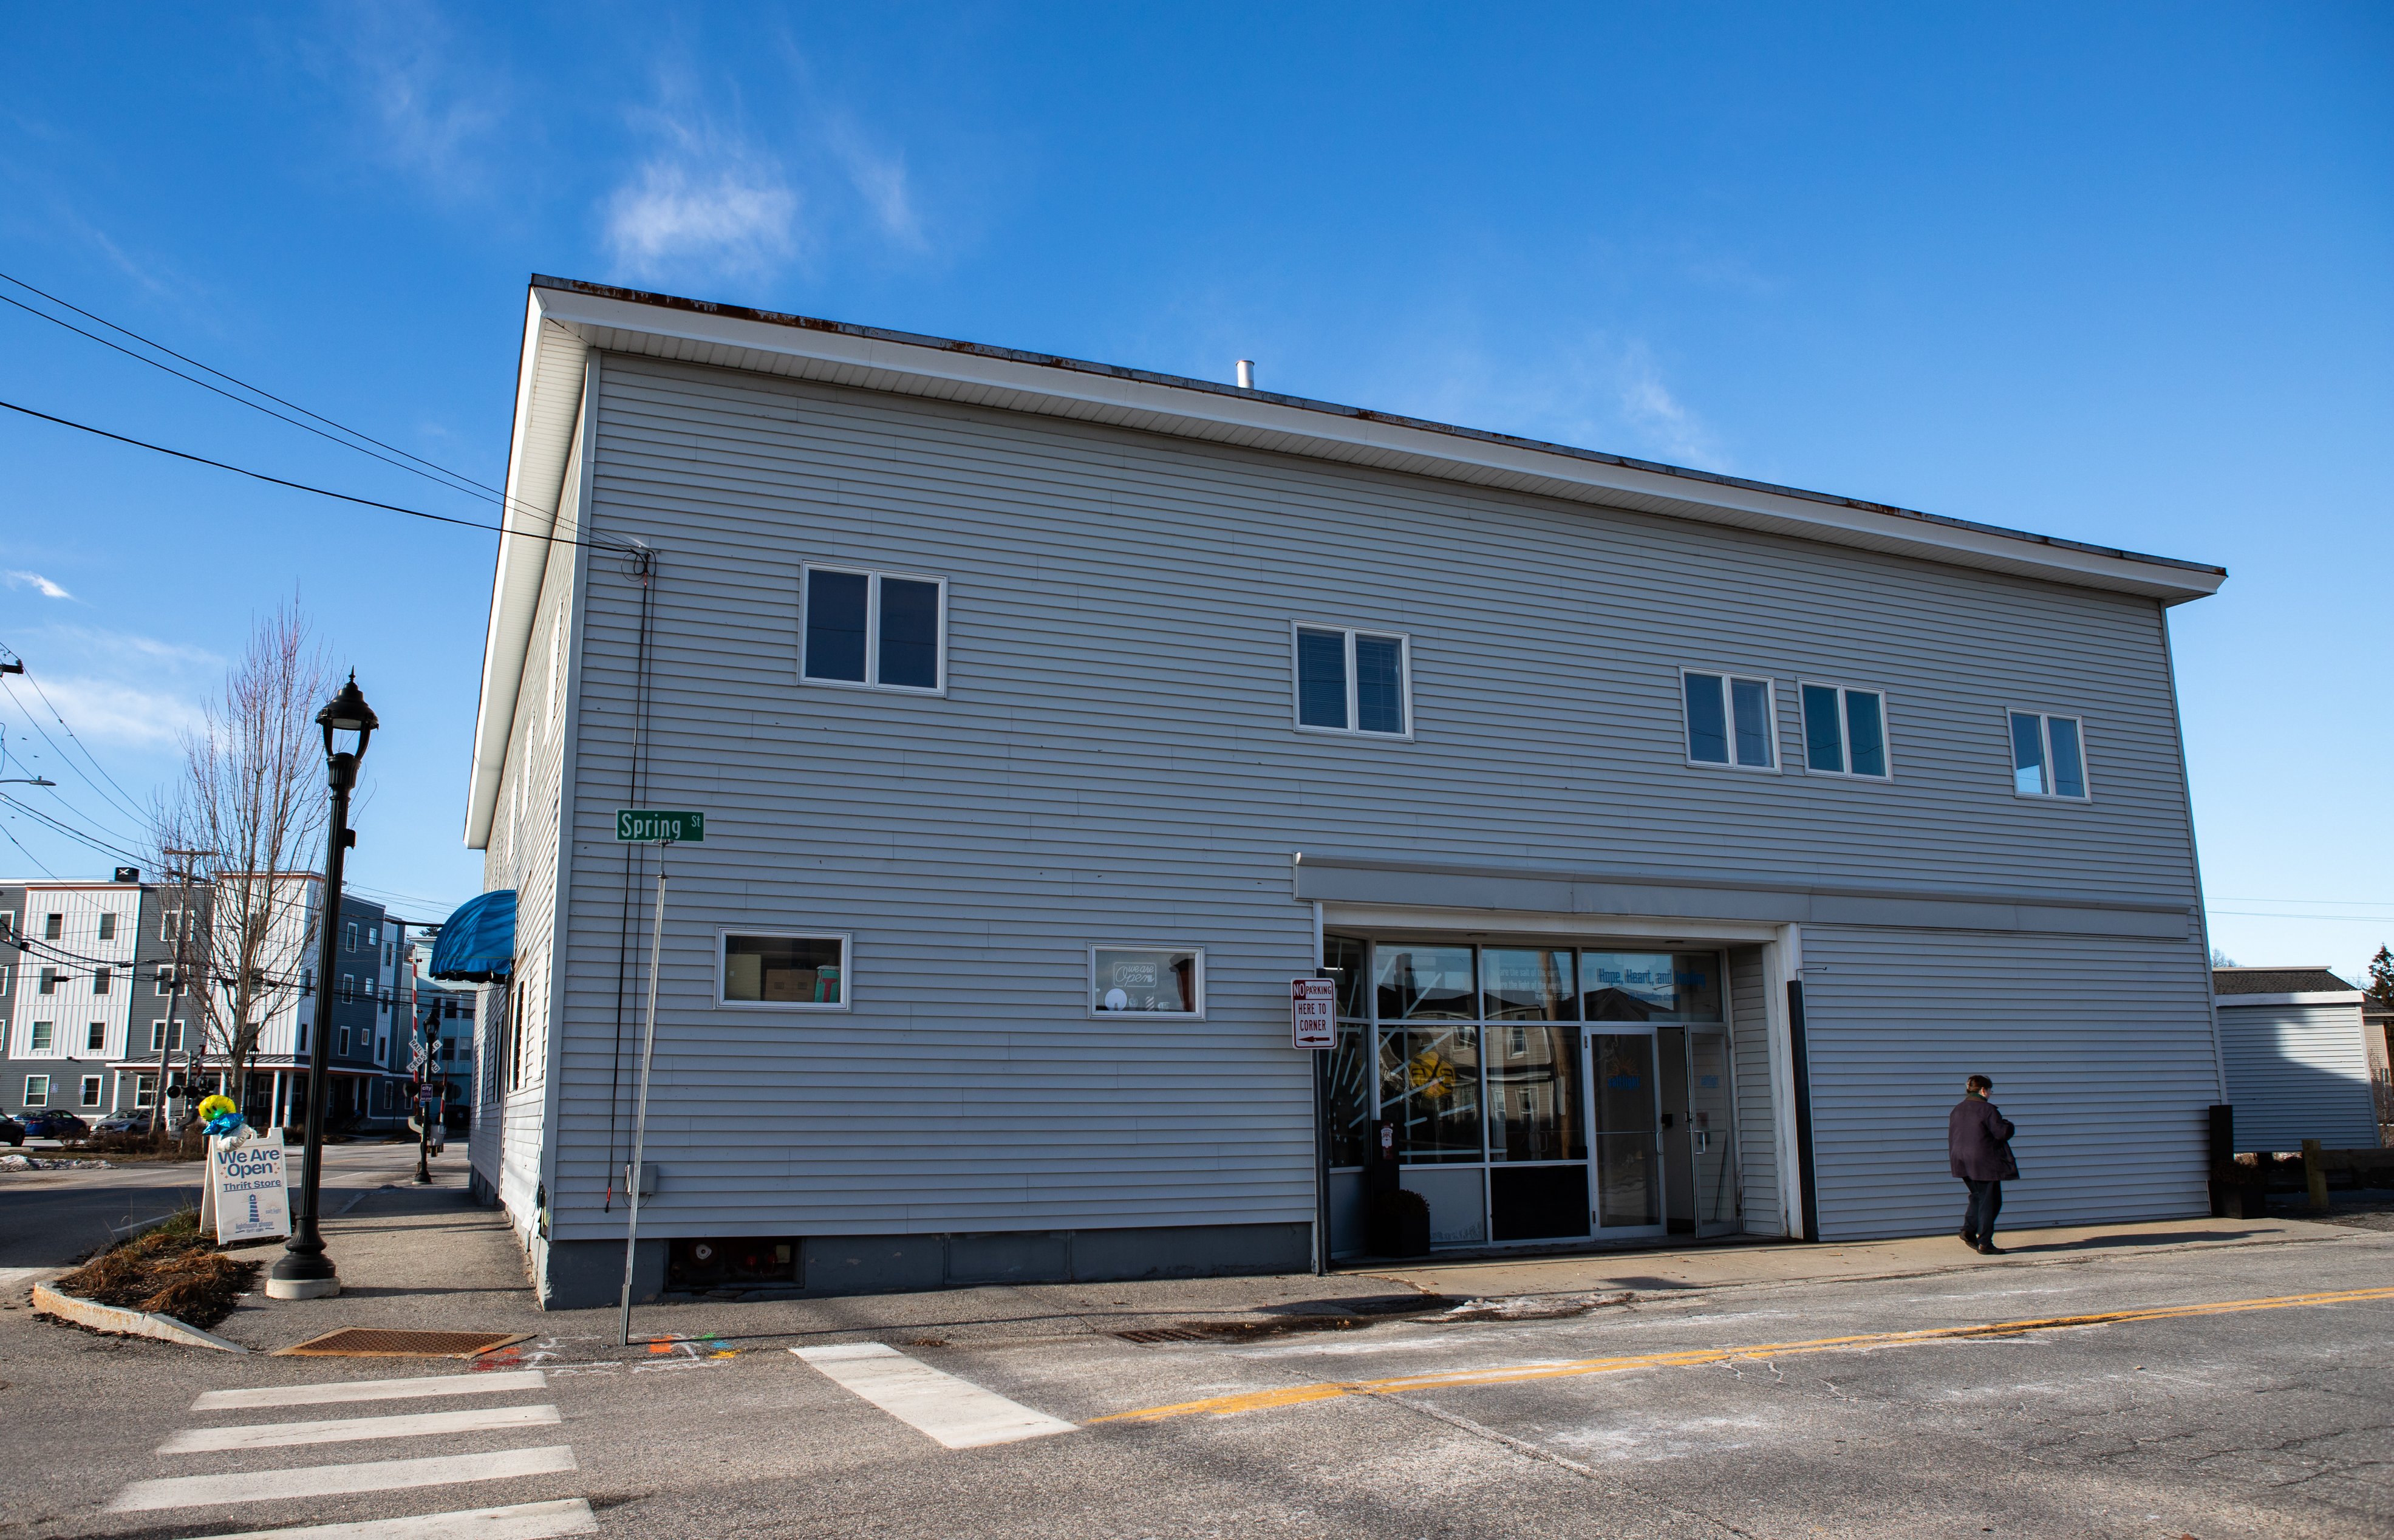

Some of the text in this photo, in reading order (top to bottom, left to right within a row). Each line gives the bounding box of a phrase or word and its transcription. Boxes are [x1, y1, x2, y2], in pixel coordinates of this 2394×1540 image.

[621, 813, 701, 839] Spring St
[1115, 966, 1155, 987] Open
[1510, 968, 1519, 976] the
[1519, 967, 1529, 976] salt
[1531, 968, 1536, 976] of
[1538, 968, 1546, 977] the
[1597, 968, 1623, 986] Hope,
[1655, 969, 1673, 984] and
[1293, 983, 1331, 997] NO PARKING
[1509, 980, 1517, 989] the
[1518, 980, 1530, 991] light
[1531, 980, 1536, 989] of
[1535, 993, 1553, 1001] Matthew
[1298, 1003, 1326, 1015] HERE TO
[1300, 1020, 1326, 1031] CORNER
[410, 1040, 423, 1054] RAIL
[218, 1148, 280, 1165] We Are
[228, 1163, 273, 1179] Open
[223, 1179, 281, 1191] Thrift Store
